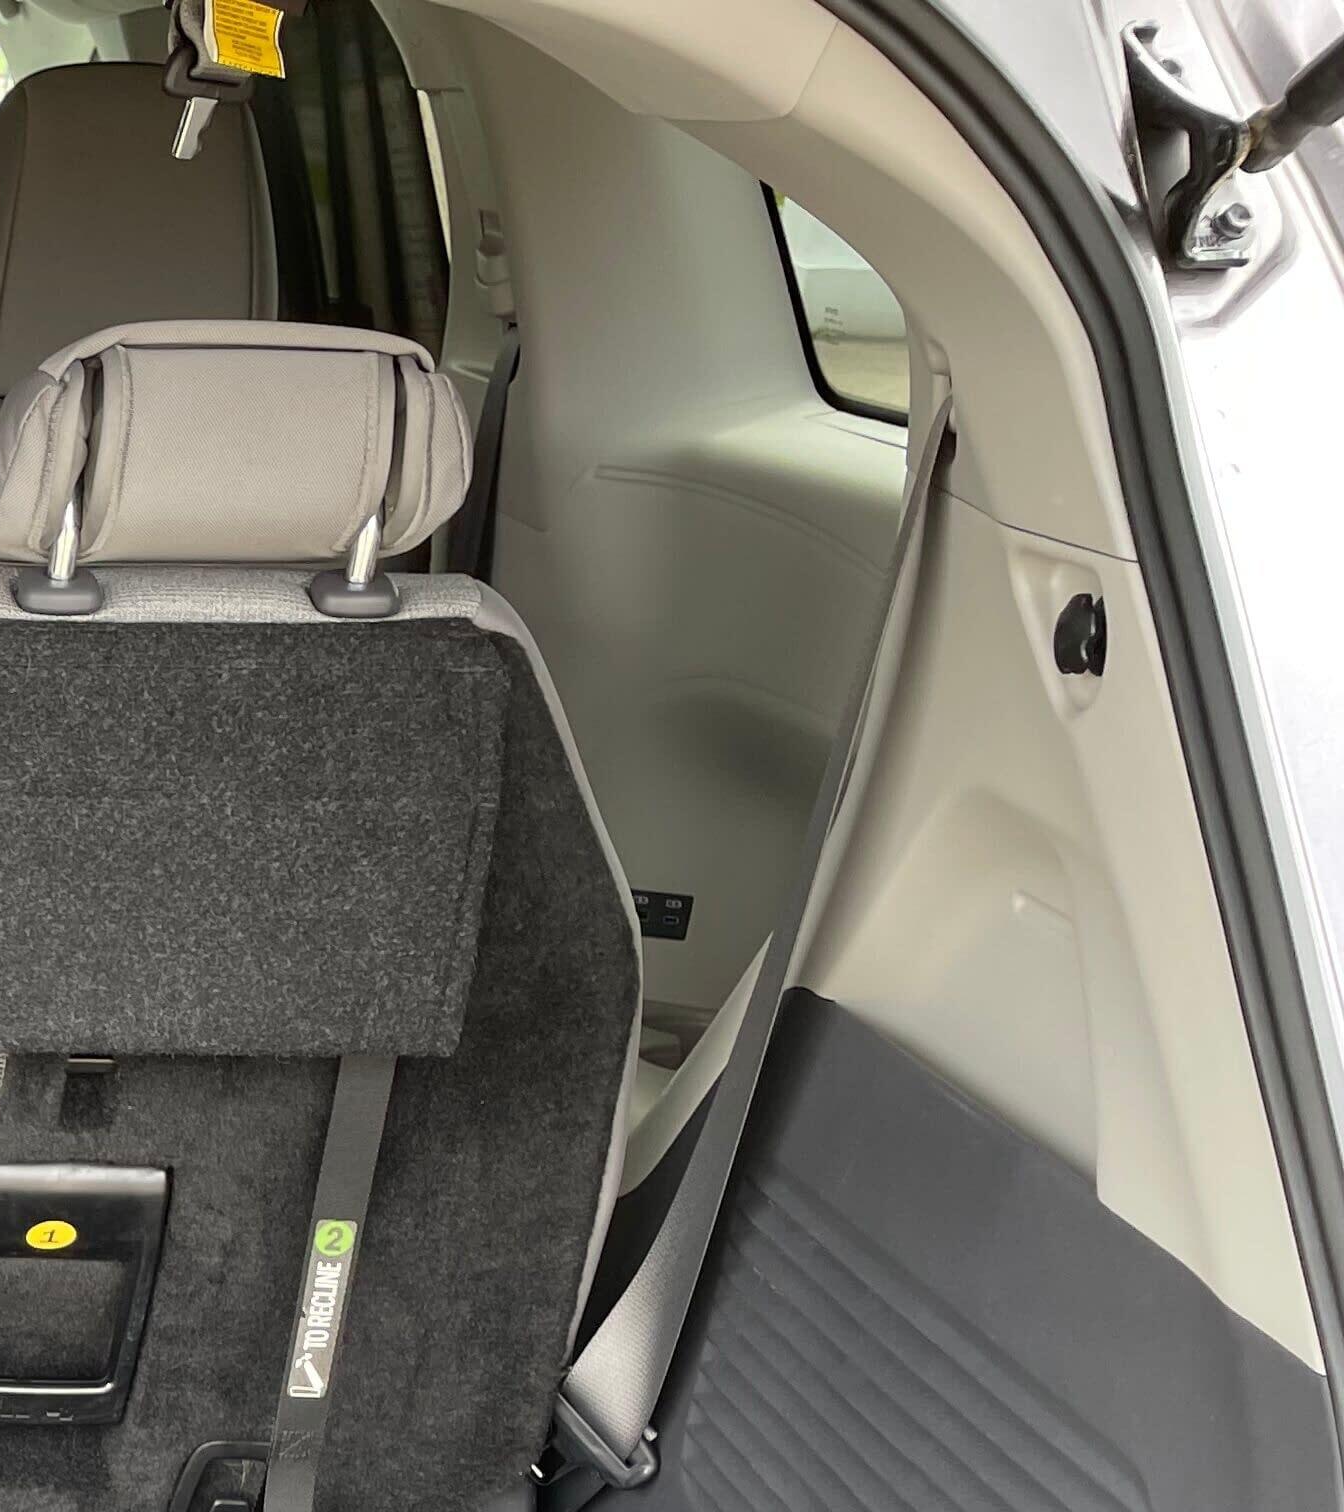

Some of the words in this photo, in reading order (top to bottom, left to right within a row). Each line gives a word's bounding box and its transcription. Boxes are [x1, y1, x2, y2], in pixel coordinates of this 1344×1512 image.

[39, 1228, 60, 1244] 1
[324, 1226, 344, 1252] 2
[307, 1260, 342, 1327] RECLINE
[303, 1329, 330, 1351] TO
